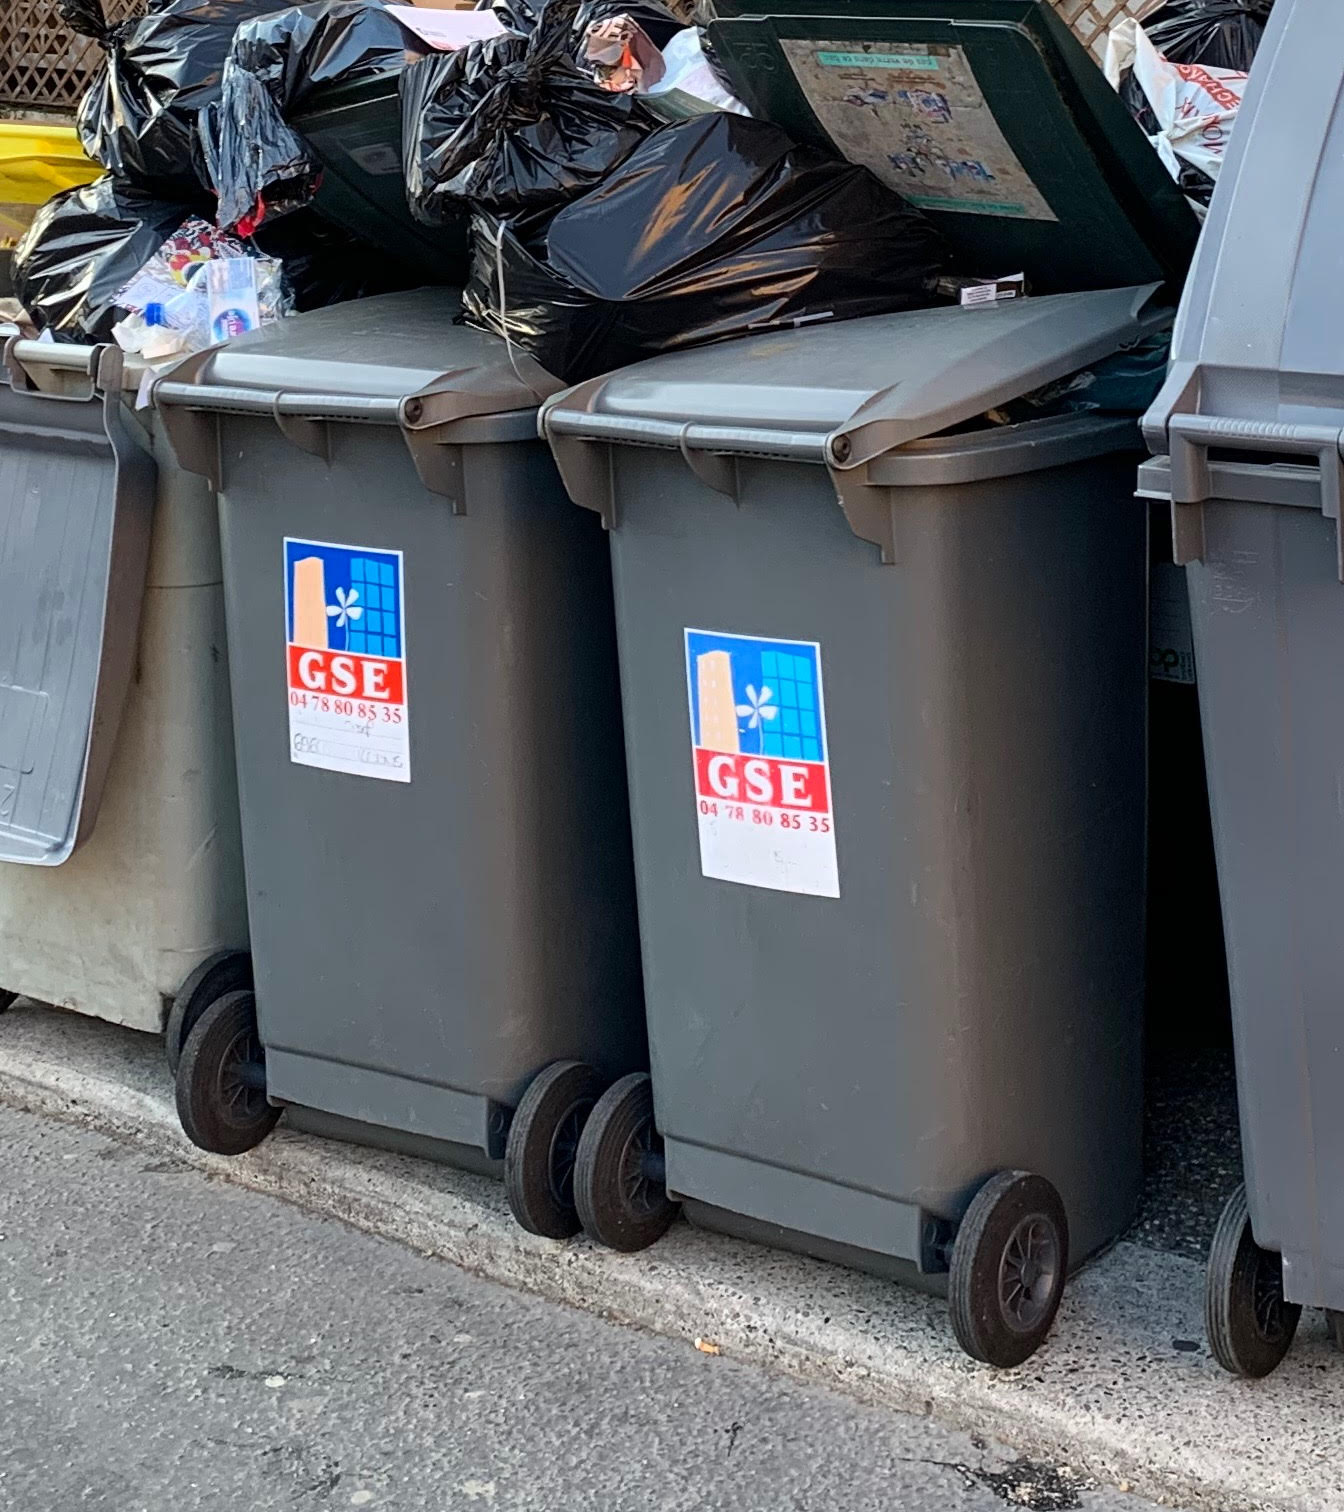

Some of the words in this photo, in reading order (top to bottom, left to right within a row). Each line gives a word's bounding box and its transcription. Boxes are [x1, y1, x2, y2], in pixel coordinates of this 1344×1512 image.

[298, 650, 390, 699] GSE
[290, 690, 307, 709] 04
[312, 694, 330, 713] 78
[334, 699, 353, 717] 80
[358, 703, 377, 721] 85
[383, 707, 402, 724] 35
[708, 754, 813, 809] GSE
[700, 799, 718, 818] 04
[725, 804, 745, 822] 78
[752, 808, 773, 827] 80
[779, 812, 801, 830] 85
[809, 815, 831, 834] 35
